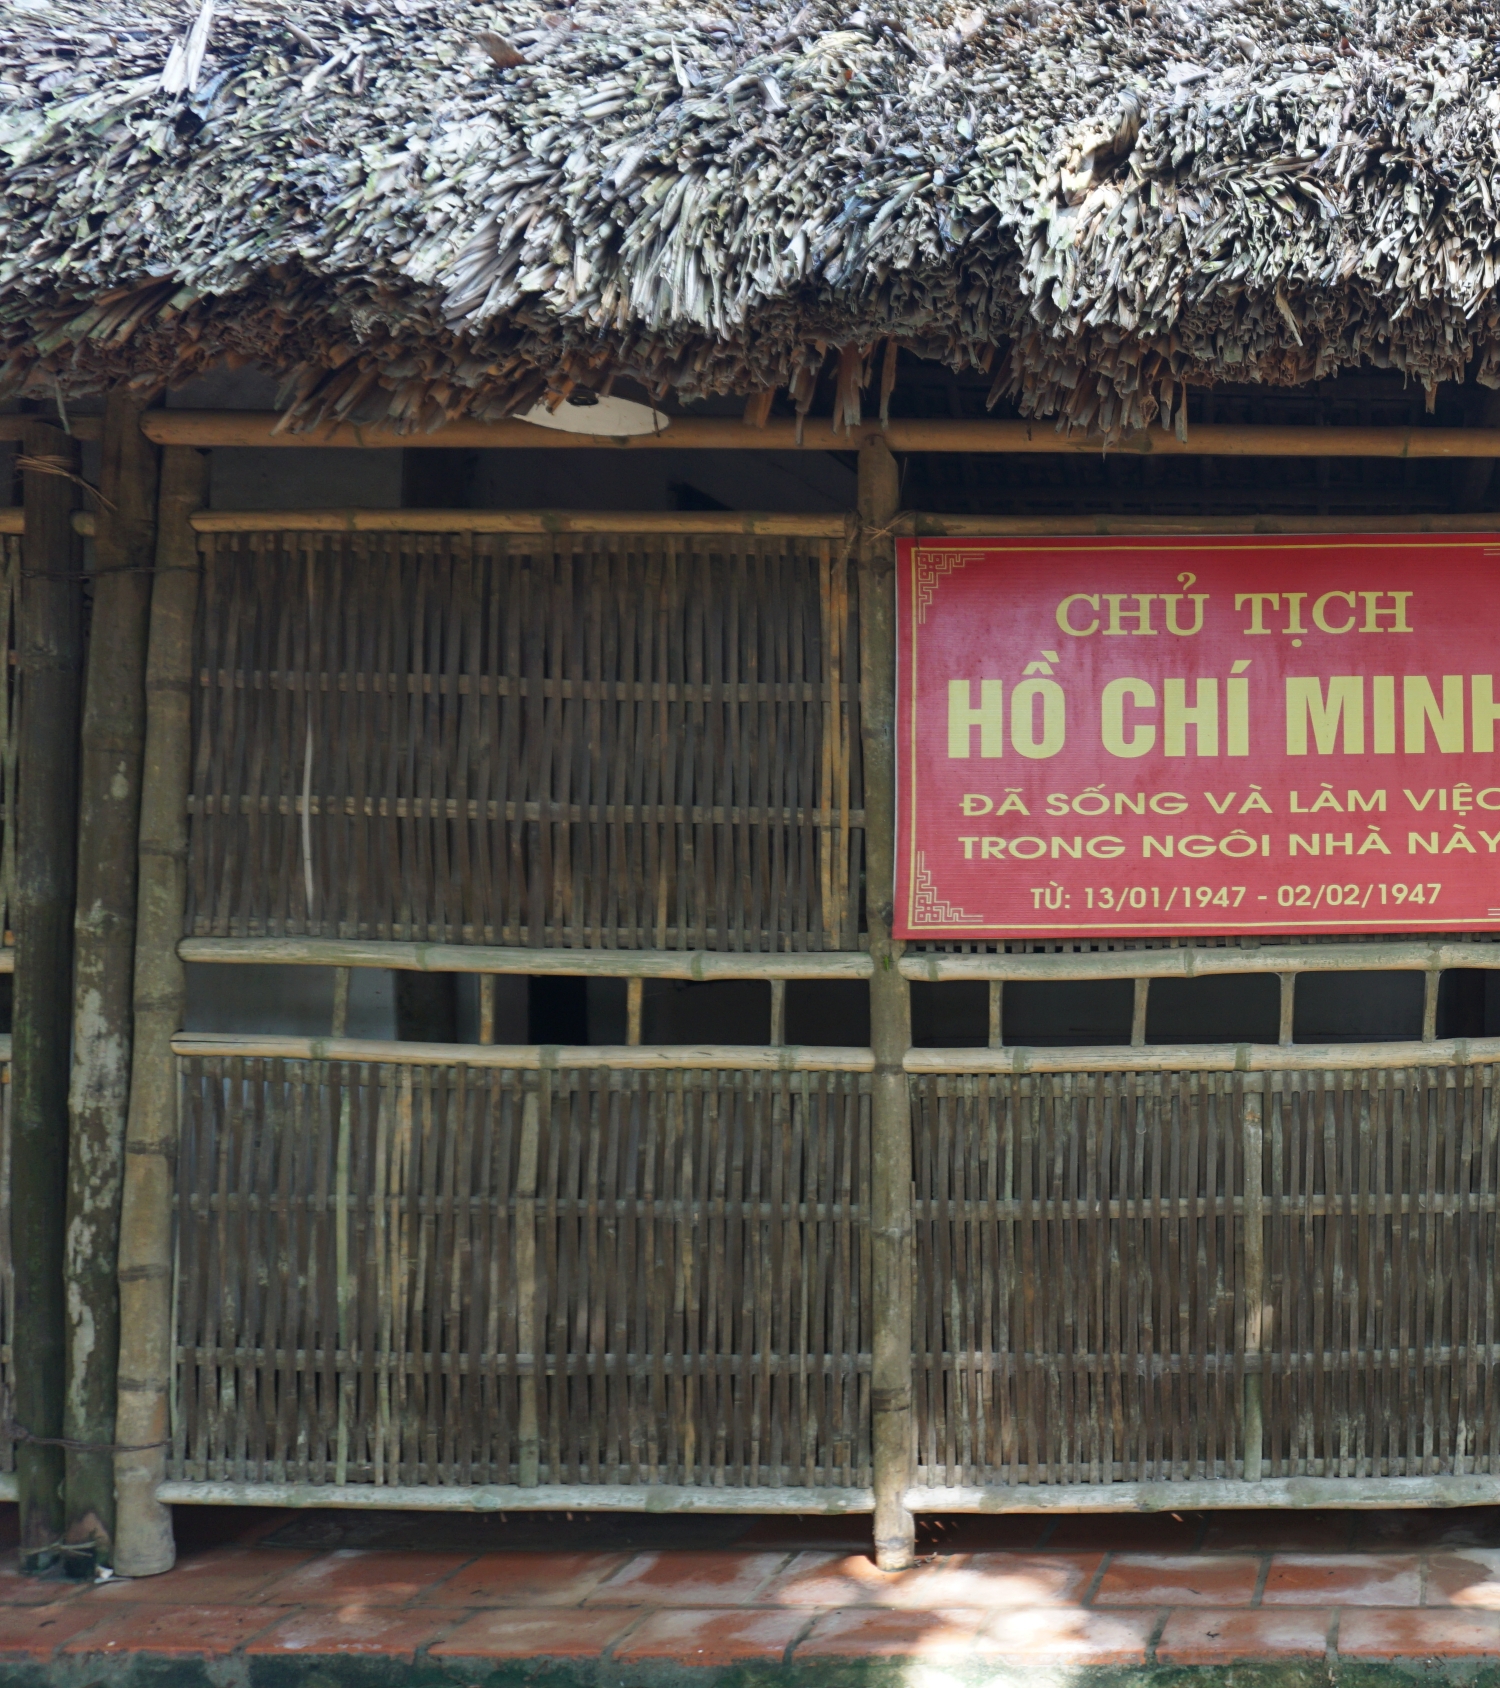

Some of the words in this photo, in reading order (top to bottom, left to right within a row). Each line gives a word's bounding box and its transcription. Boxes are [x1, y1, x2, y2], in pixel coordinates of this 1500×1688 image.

[1056, 573, 1209, 636] CHỦ
[1235, 591, 1413, 647] TỊCH
[948, 650, 1065, 759] HỒ
[1101, 660, 1251, 758] CHÍ
[959, 788, 1030, 816] ĐÃ
[1046, 784, 1188, 816] SỐNG
[1204, 784, 1272, 814] VÀ
[1290, 783, 1386, 813] LÀM
[958, 835, 1126, 859] TRONG
[1143, 829, 1270, 858] NGÔI
[1289, 825, 1391, 856] NHÀ
[1030, 881, 1070, 909] TỪ:
[1085, 886, 1246, 911] 13/01/1947
[1278, 883, 1441, 908] 02/02/1947
